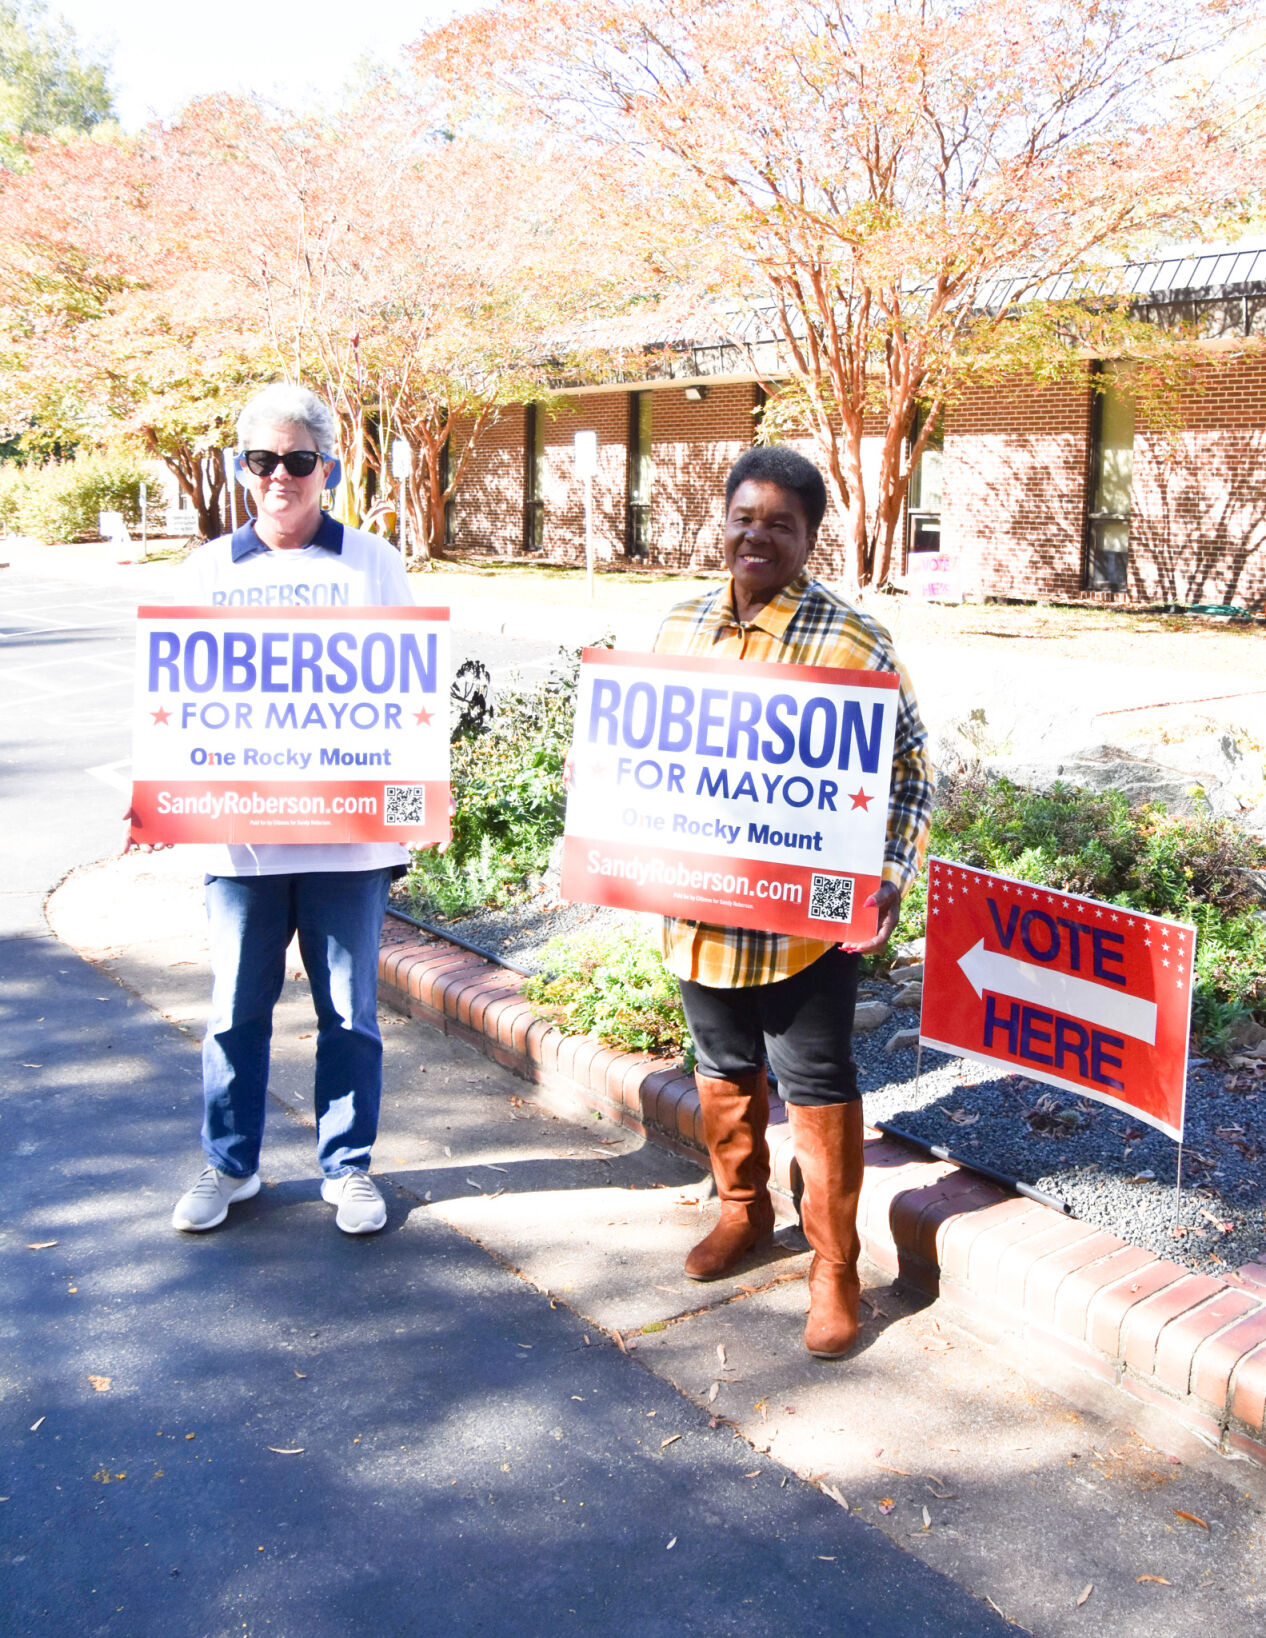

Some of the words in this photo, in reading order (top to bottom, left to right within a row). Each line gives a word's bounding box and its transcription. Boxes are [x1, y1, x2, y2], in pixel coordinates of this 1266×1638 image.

[149, 631, 437, 694] ROBERSON
[181, 702, 253, 729] FOR
[264, 702, 402, 730] MAYOR
[587, 678, 885, 774] ROBERSON
[243, 748, 312, 770] Rocky
[319, 748, 392, 766] Mount
[616, 757, 686, 793] FOR
[696, 767, 839, 812] MAYOR
[157, 791, 377, 819] SandyRoberson.com
[672, 813, 741, 843] Rocky
[747, 823, 823, 851] Mount
[587, 850, 802, 904] SandyRoberson.com
[986, 898, 1126, 986] VOTE
[983, 996, 1124, 1091] HERE
